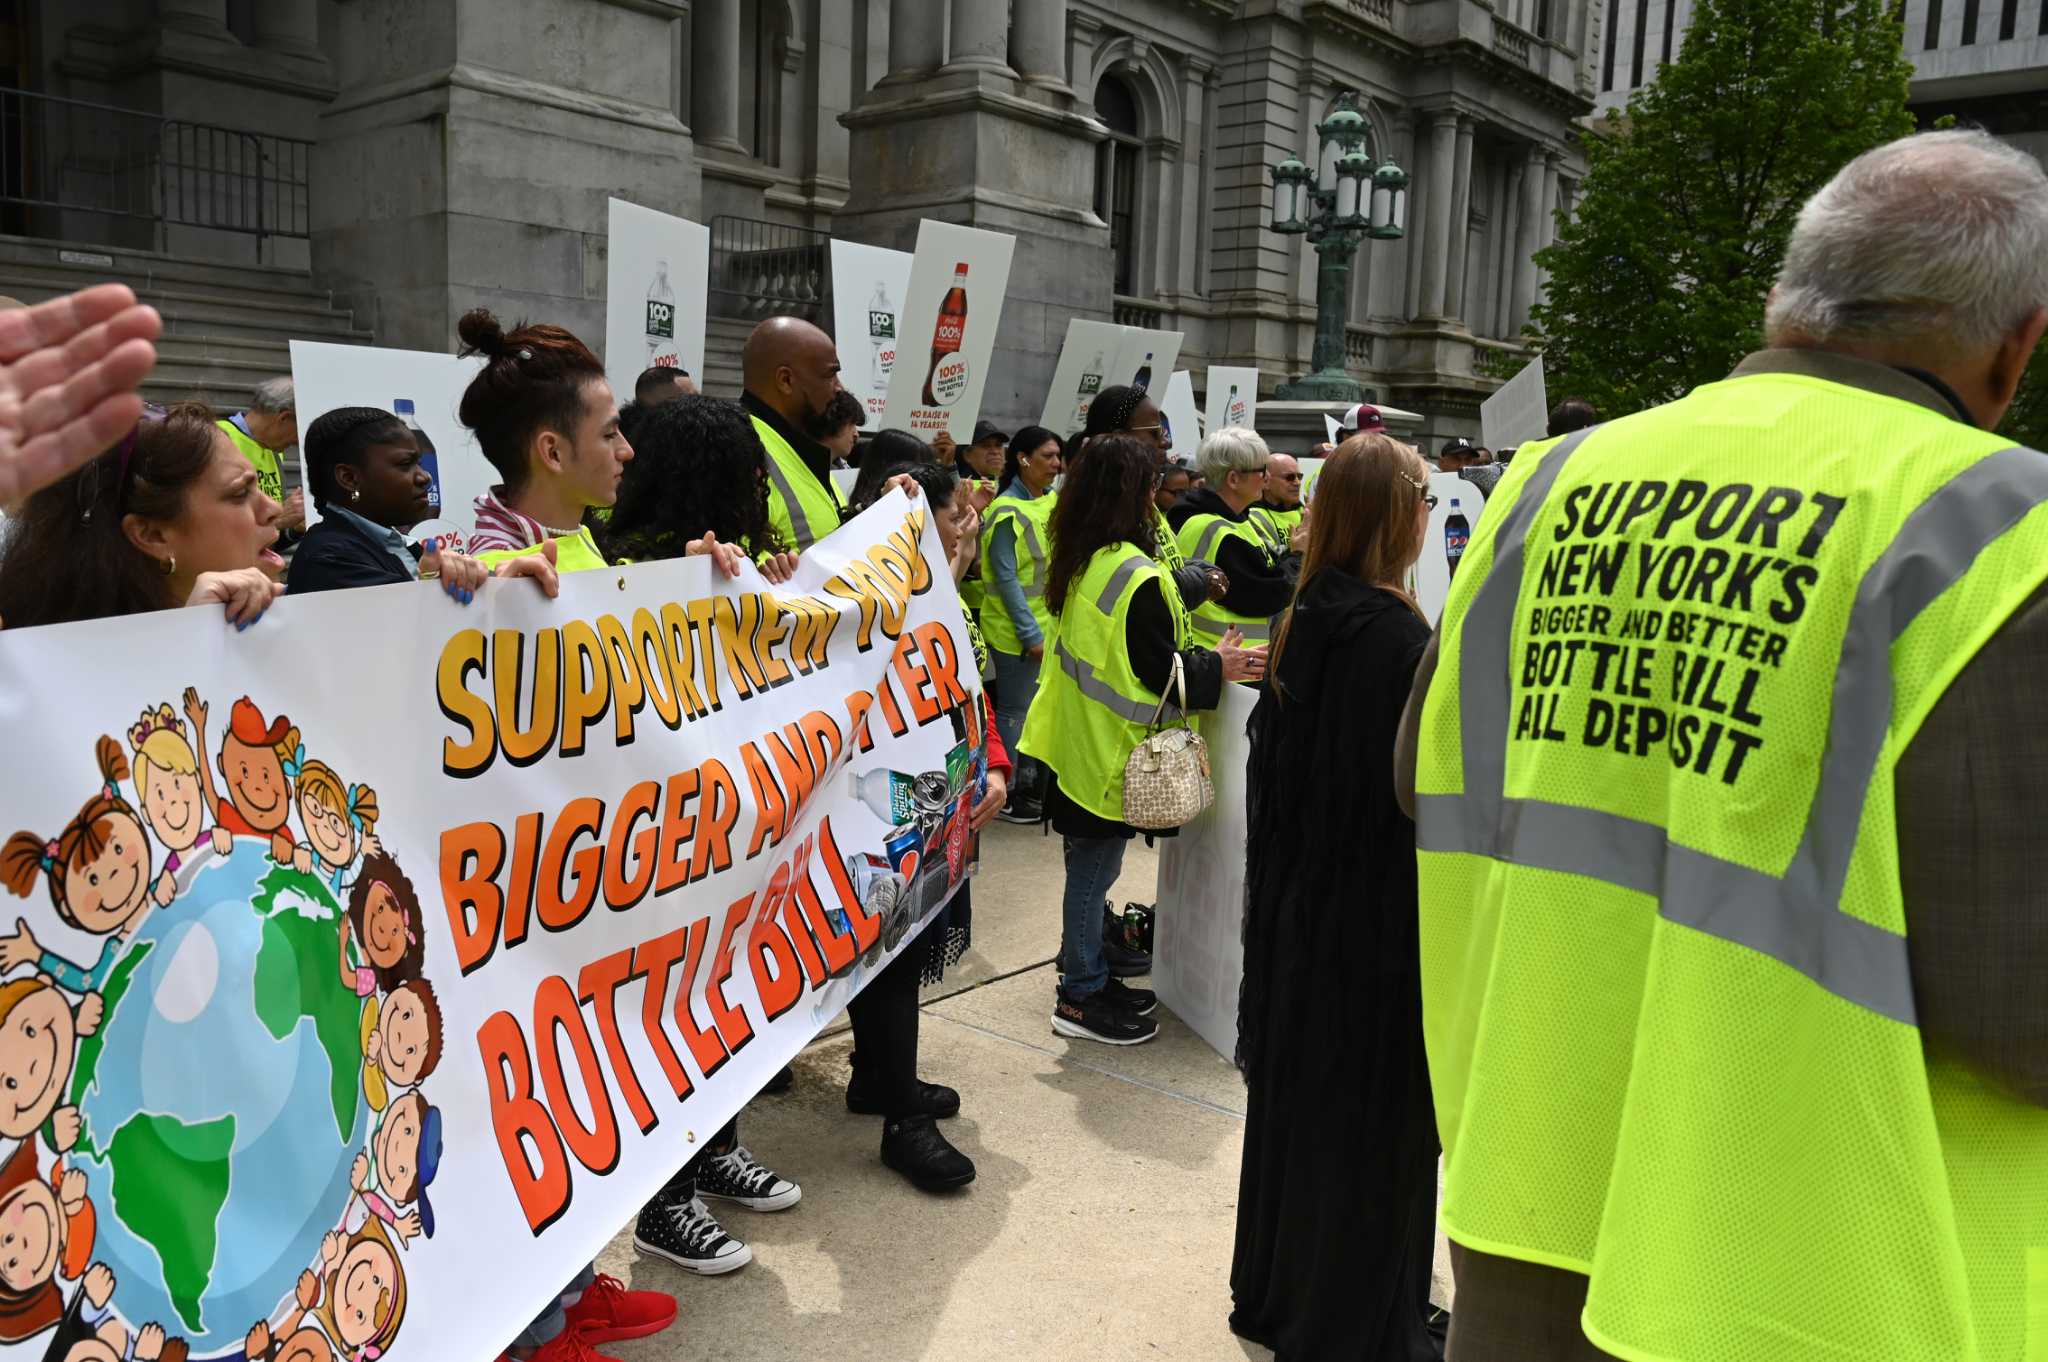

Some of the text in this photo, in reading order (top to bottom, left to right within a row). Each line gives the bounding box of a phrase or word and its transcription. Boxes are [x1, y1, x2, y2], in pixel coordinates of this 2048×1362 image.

[880, 351, 895, 361] 100
[939, 362, 965, 379] 100%
[1554, 479, 1847, 560] SUPPORT
[1536, 541, 1819, 625] NEW YORK'S
[1522, 639, 1655, 699] BOTTLE
[1530, 604, 1789, 668] BIGGER AND BETTER
[436, 598, 723, 779] SUPPORT
[713, 592, 841, 700] NEW
[1515, 693, 1763, 786] ALL DEPSIT
[439, 757, 740, 977] BIGGER
[739, 710, 843, 860] AND
[476, 893, 756, 1238] BOTTLE
[747, 815, 882, 1024] BILL
